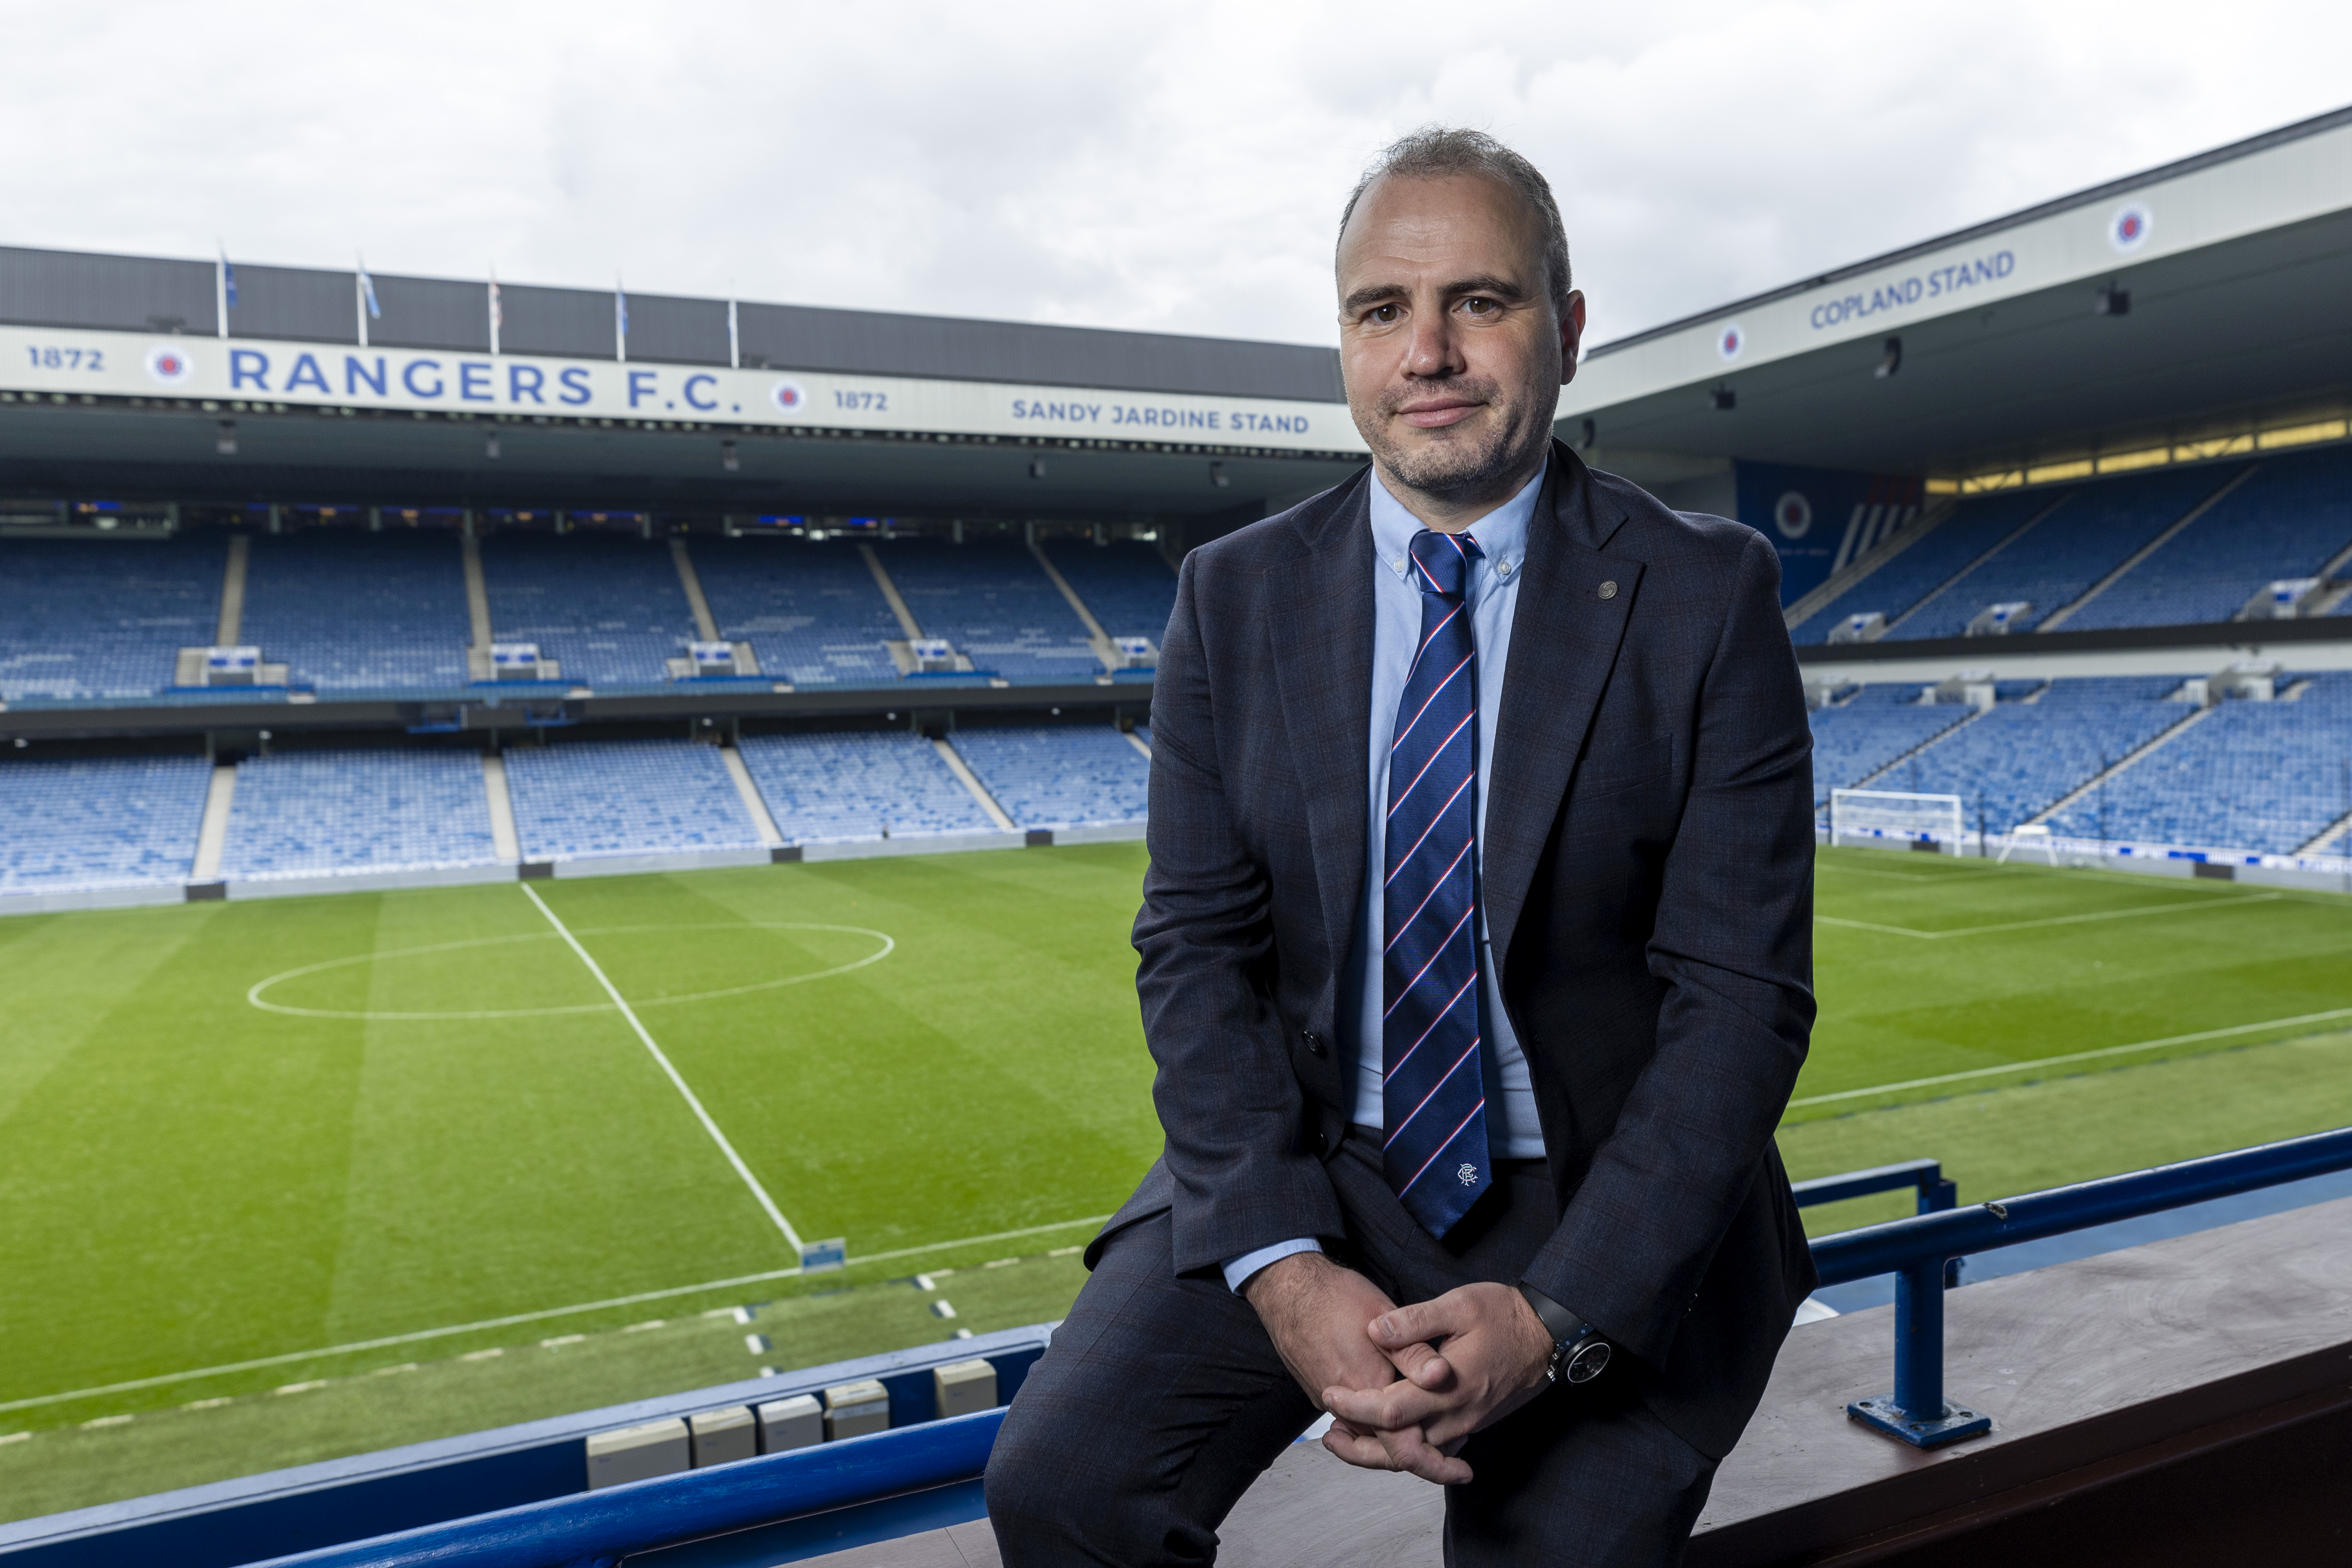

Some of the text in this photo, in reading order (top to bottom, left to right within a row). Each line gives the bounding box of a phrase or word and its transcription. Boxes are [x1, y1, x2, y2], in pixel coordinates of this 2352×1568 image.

[1810, 250, 2015, 330] COPLAND STAND
[28, 346, 104, 371] 1872
[229, 348, 741, 413] RANGERS F.C.
[835, 390, 888, 410] 1872
[1012, 399, 1309, 434] SANDY JARDINE STAND
